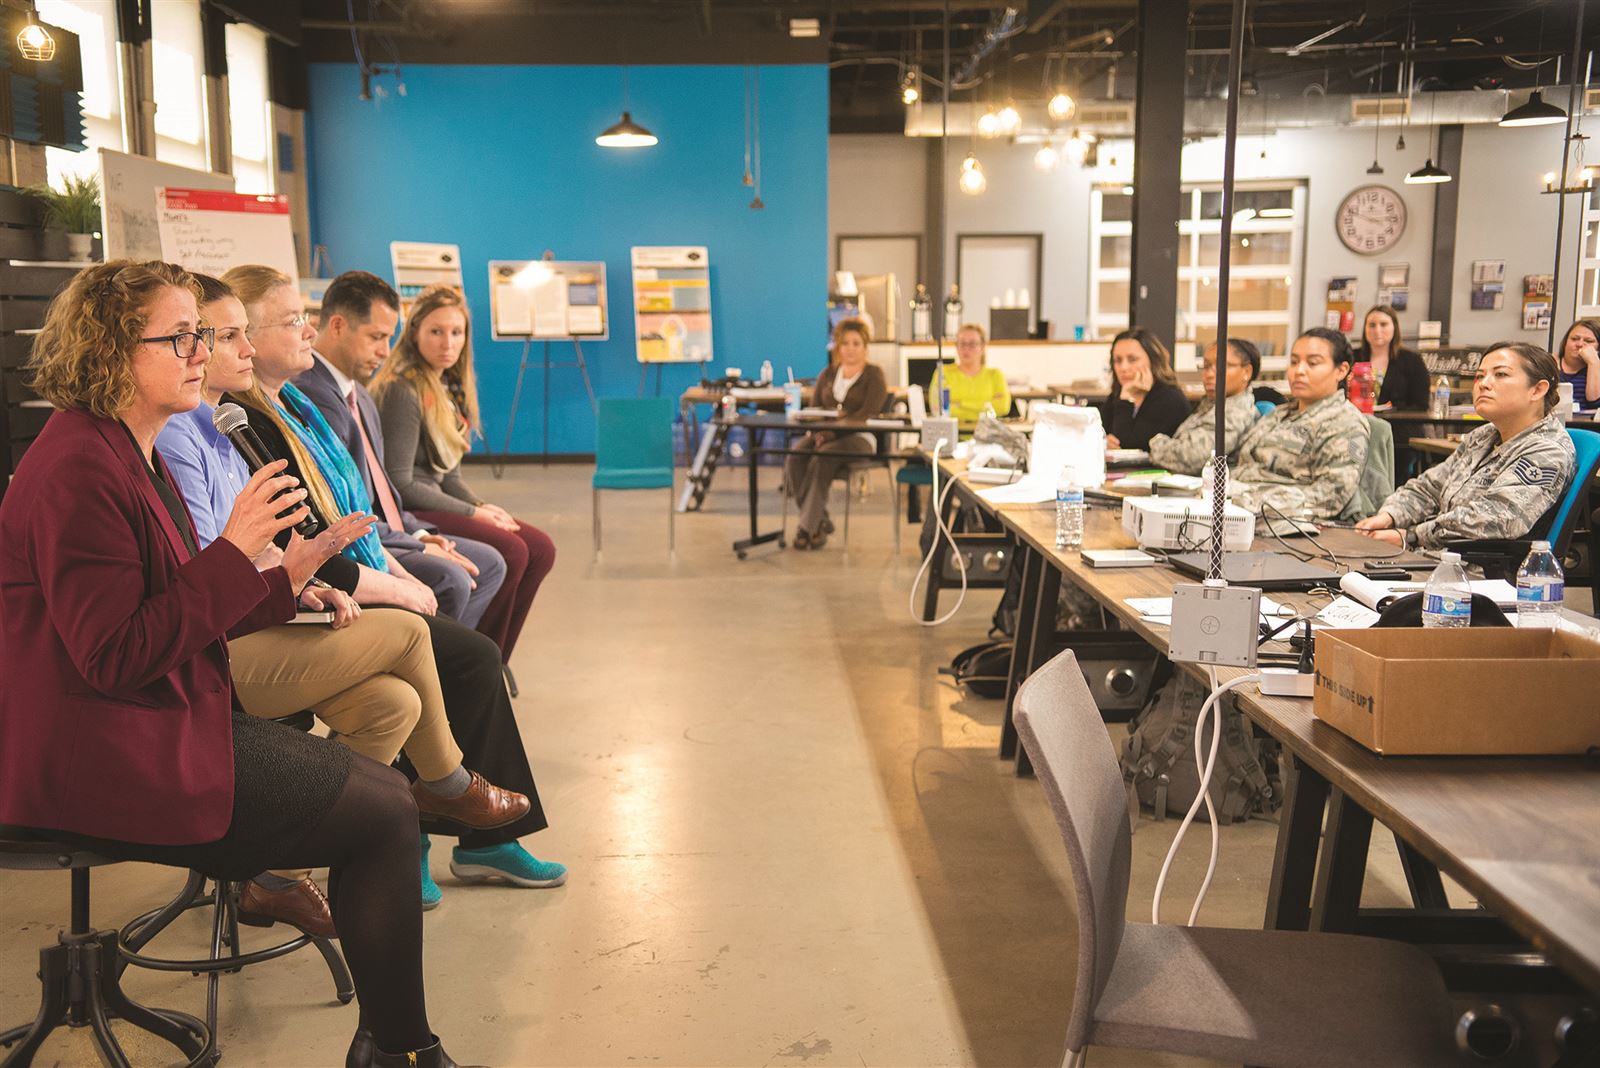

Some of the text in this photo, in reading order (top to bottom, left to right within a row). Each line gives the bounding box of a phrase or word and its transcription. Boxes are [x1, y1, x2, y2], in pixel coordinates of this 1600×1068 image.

[1323, 675, 1368, 708] THIS SIDE UP
